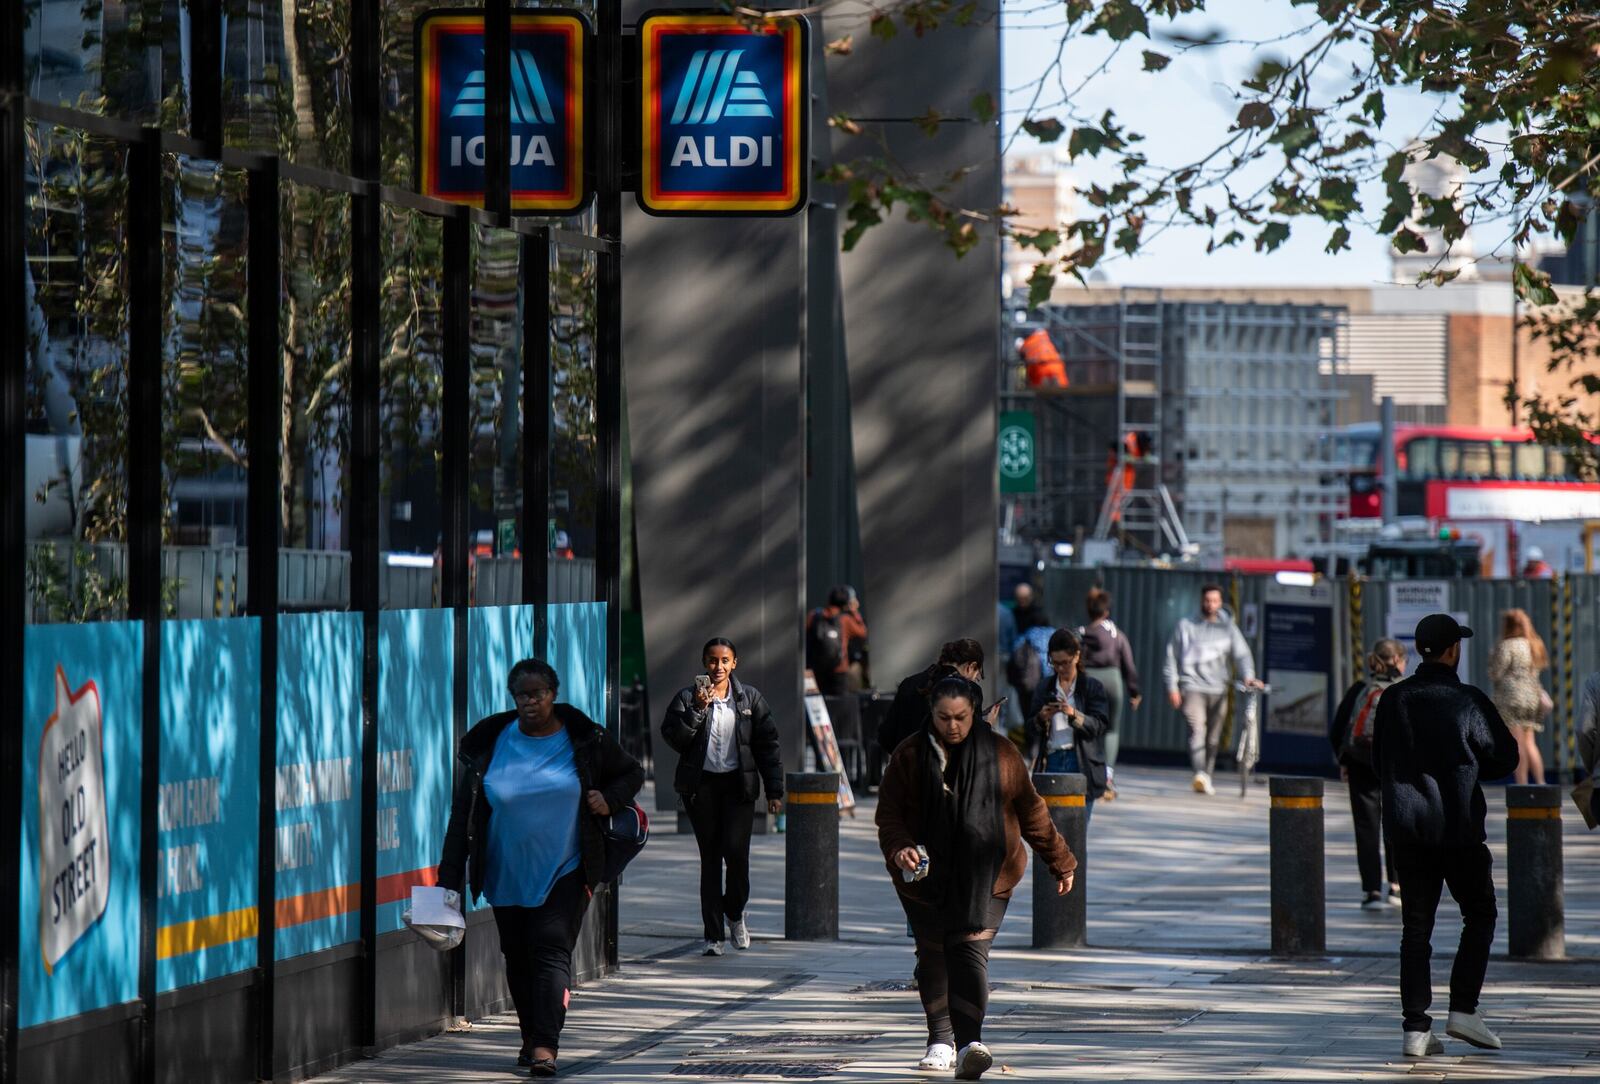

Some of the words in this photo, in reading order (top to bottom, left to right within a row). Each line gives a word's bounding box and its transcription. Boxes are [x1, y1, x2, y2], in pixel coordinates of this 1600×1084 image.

[670, 136, 773, 167] ALDI
[58, 729, 86, 784] HELLO
[62, 784, 86, 846] OLD
[187, 776, 220, 828] FARM
[275, 822, 314, 872] UALITY.
[53, 838, 97, 924] STREET
